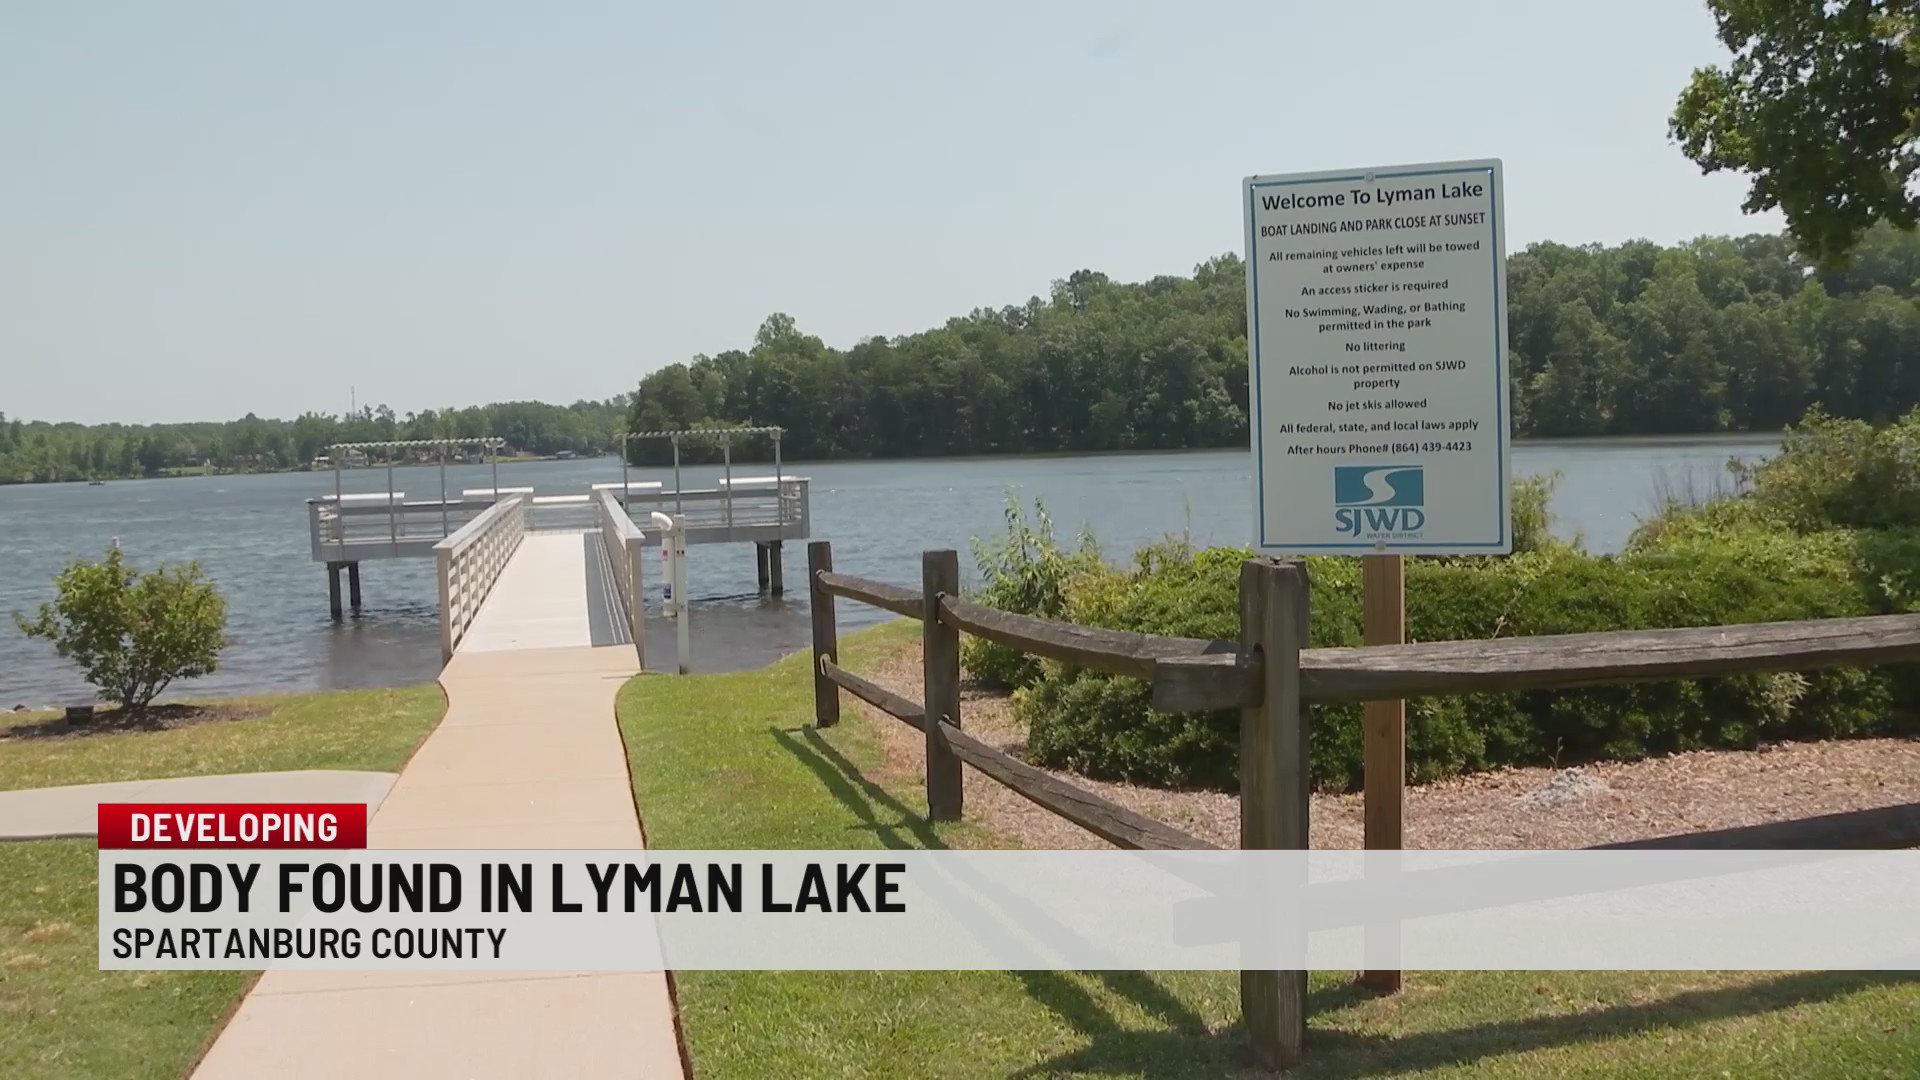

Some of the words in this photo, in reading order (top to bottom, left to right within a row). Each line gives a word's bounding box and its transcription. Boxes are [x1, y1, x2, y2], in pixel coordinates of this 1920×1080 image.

[1262, 192, 1345, 210] Welcome
[1351, 190, 1370, 205] To
[1377, 186, 1435, 205] Lyman
[1442, 182, 1483, 198] Lake
[1261, 224, 1287, 237] BOAT
[1290, 221, 1337, 235] LANDING
[1340, 219, 1363, 232] AND
[1366, 217, 1392, 231] PARK
[1395, 215, 1426, 229] CLOSE
[1429, 215, 1442, 226] AT
[1445, 212, 1485, 225] SUNSET
[1269, 252, 1282, 262] All
[1286, 249, 1338, 261] remaining
[1341, 246, 1382, 257] vehicles
[1386, 244, 1404, 255] left
[1407, 243, 1426, 253] will
[1429, 242, 1442, 252] be
[1445, 240, 1479, 251] towed
[1323, 264, 1333, 273] at
[1336, 261, 1378, 273] owners'
[1381, 259, 1424, 271] expense
[1302, 286, 1315, 296] An
[1318, 284, 1351, 295] access
[1354, 282, 1388, 293] sticker
[1392, 282, 1400, 292] is
[1403, 280, 1448, 293] required
[1285, 309, 1299, 318] No
[1303, 305, 1361, 317] Swimming,
[1363, 304, 1407, 315] Wading,
[1410, 304, 1421, 312] or
[1424, 301, 1465, 313] Bathing
[1319, 320, 1370, 333] permitted
[1374, 320, 1383, 329] in
[1386, 319, 1404, 329] the
[1408, 317, 1431, 329] park
[1346, 342, 1360, 352] No
[1363, 341, 1405, 352] littering
[1289, 365, 1328, 376] Alcohol
[1331, 364, 1339, 374] is
[1342, 364, 1359, 374] not
[1363, 361, 1415, 374] permitted
[1418, 362, 1432, 371] on
[1436, 361, 1465, 371] SJWD
[1354, 378, 1400, 390] property
[1328, 401, 1343, 411] No
[1346, 400, 1359, 412] jet
[1363, 399, 1382, 409] skis
[1385, 398, 1426, 409] allowed
[1280, 423, 1293, 433] All
[1296, 422, 1336, 433] federal,
[1339, 422, 1367, 433] state,
[1371, 421, 1390, 431] and
[1394, 421, 1418, 431] local
[1422, 420, 1445, 430] laws
[1449, 419, 1479, 431] apply
[1287, 444, 1314, 455] After
[1316, 443, 1345, 454] hours
[1349, 443, 1388, 453] Phone#
[1392, 443, 1419, 454] (864)
[1422, 442, 1471, 452] 439-4423
[1336, 508, 1424, 538] SJWD
